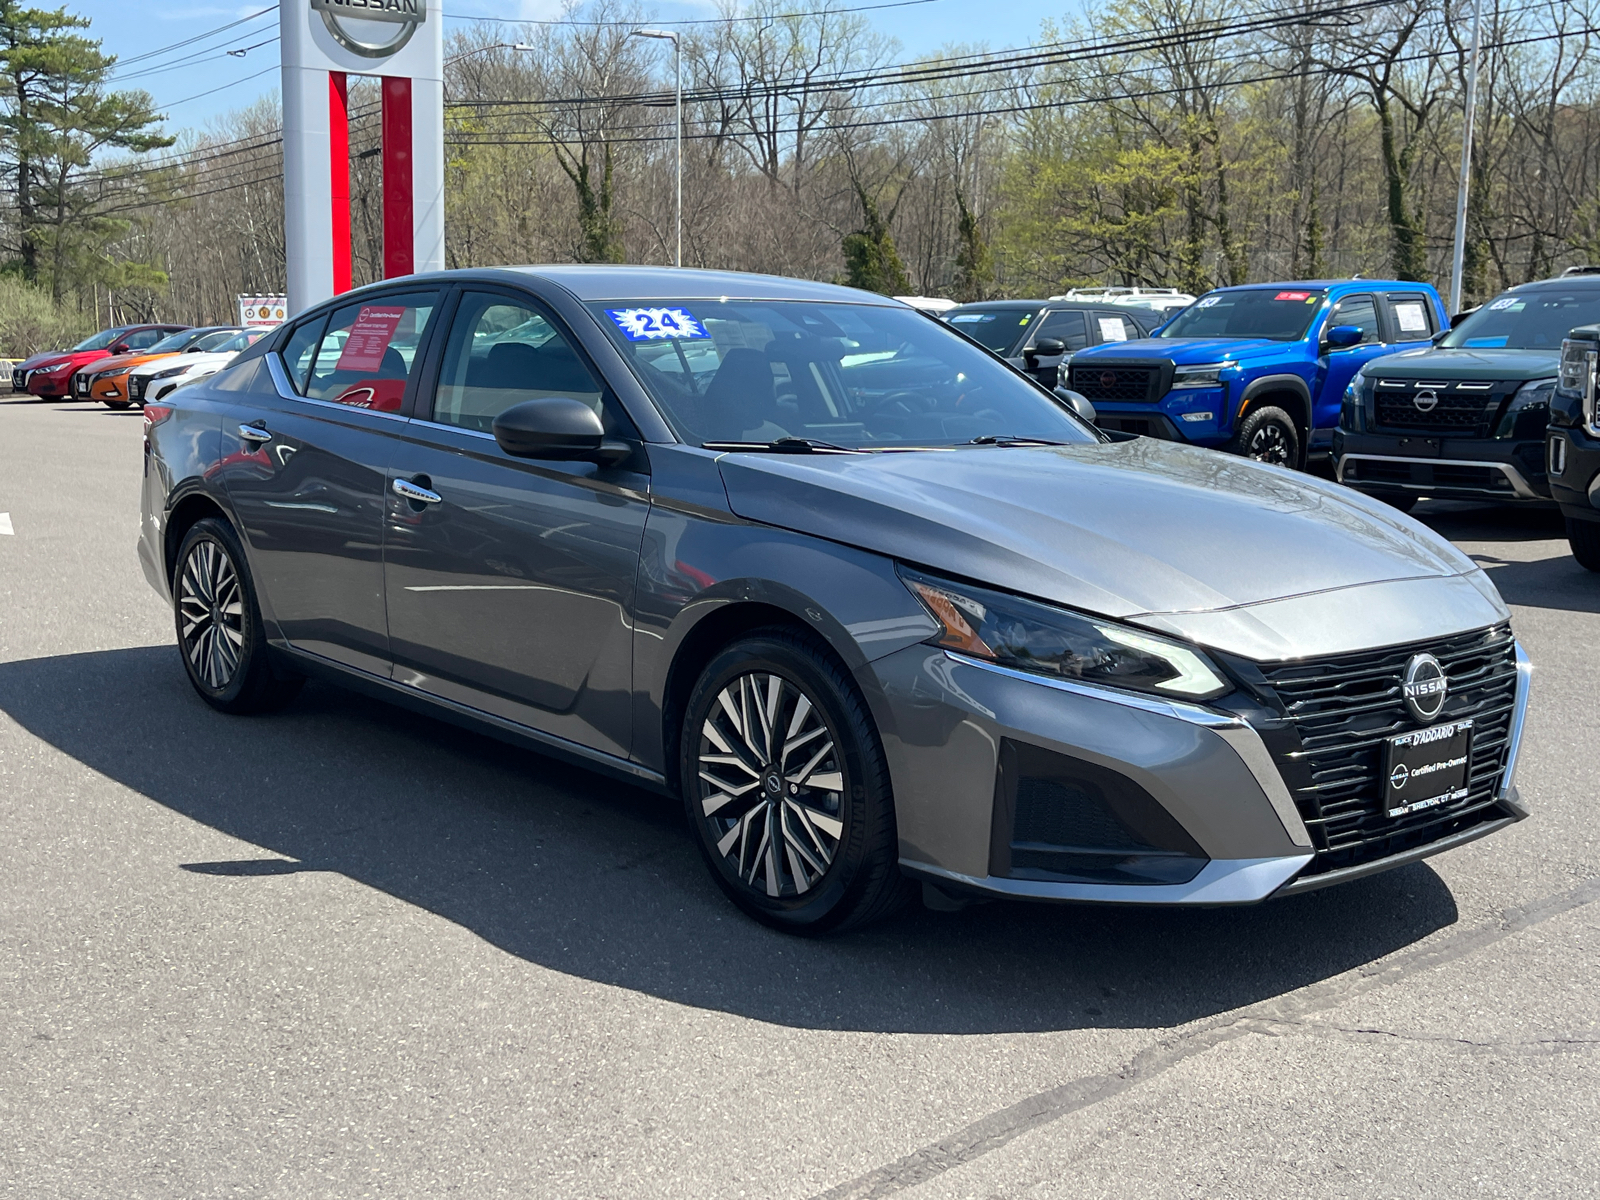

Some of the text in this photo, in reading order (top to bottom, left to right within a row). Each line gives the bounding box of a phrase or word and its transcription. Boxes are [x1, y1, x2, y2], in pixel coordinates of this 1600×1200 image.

[635, 313, 681, 331] 24
[1404, 679, 1447, 697] NISSAN
[1413, 725, 1454, 746] D'ADDARIO
[1411, 755, 1467, 777] Certified Pre-Owned
